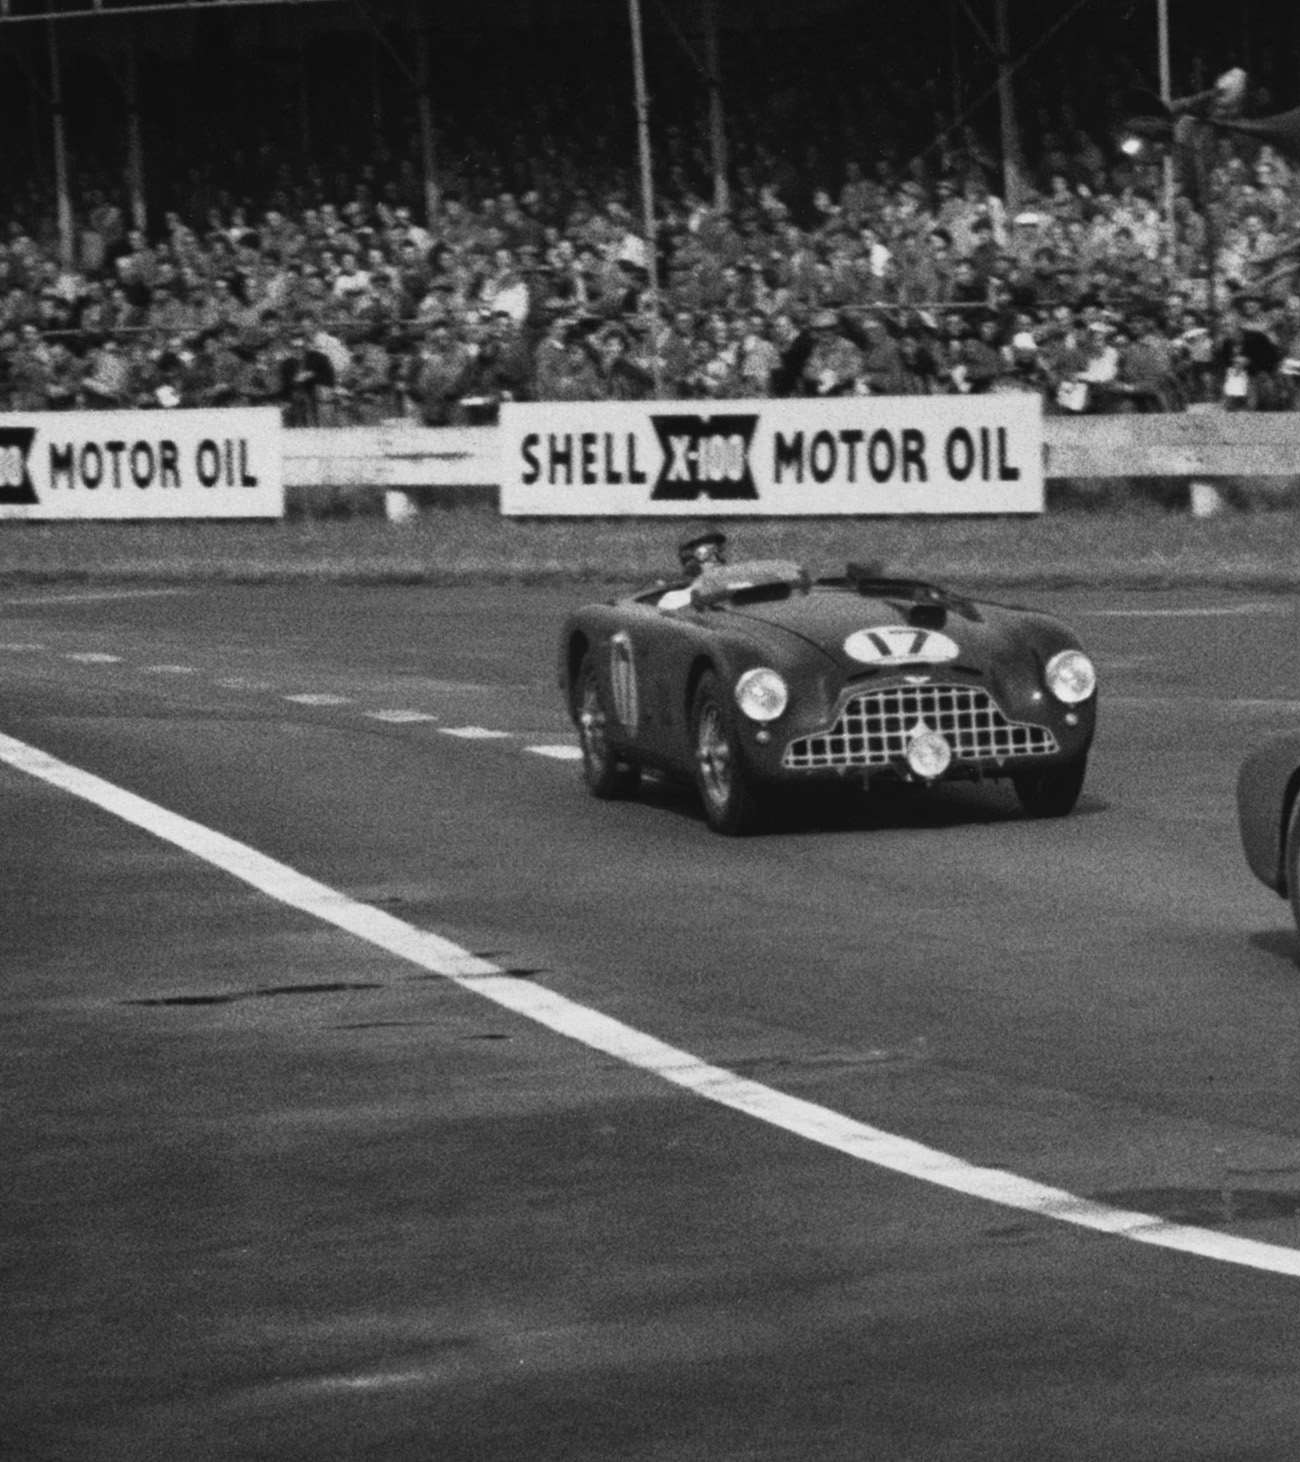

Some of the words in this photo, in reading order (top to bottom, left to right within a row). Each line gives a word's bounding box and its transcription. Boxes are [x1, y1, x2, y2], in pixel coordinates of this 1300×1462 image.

[48, 439, 181, 490] MOTOR
[195, 438, 259, 488] OIL
[520, 432, 648, 486] SHELL
[667, 434, 745, 483] X-100
[773, 427, 928, 484] MOTOR
[944, 426, 1021, 482] OIL
[867, 630, 931, 657] 17
